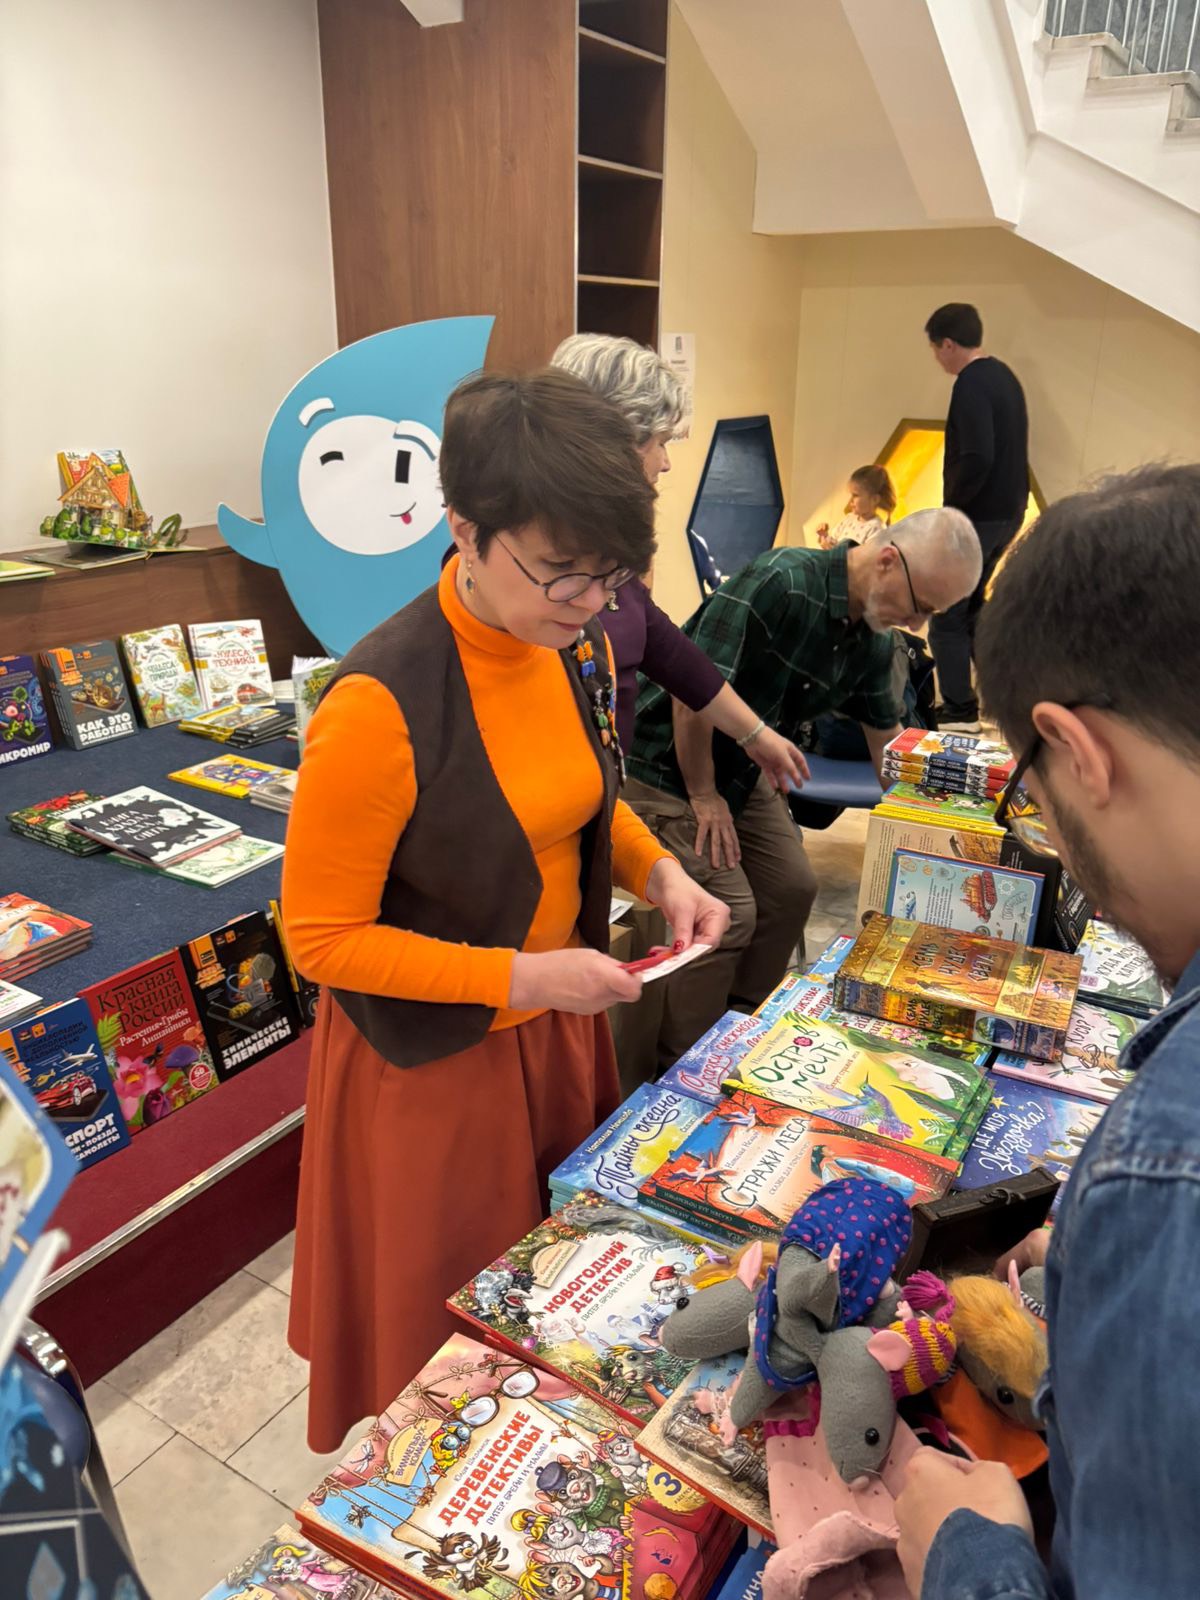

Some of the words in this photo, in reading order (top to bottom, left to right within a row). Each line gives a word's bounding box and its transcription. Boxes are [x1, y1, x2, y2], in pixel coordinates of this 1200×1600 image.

[76, 718, 105, 734] КАК
[107, 712, 131, 726] ЭТО
[79, 721, 133, 742] РАБОТАЕТ
[97, 967, 177, 1012] Красная
[129, 980, 182, 1014] книга
[118, 993, 186, 1034] России
[221, 1016, 289, 1058] ХИМИЧЕСКИЕ
[223, 1025, 292, 1070] ЭЛЕМЕНТЫ
[680, 1054, 733, 1095] Сказки
[715, 1016, 760, 1051] снежного
[748, 1024, 820, 1083] Остров
[585, 1130, 613, 1154] Наталия
[775, 1117, 812, 1151] ЛЕСА
[972, 1131, 994, 1150] ГДЕ
[981, 1112, 1010, 1133] МОЯ
[593, 1134, 640, 1200] Тайны
[633, 1094, 681, 1136] океана
[543, 1240, 629, 1314] НОВОГОДНИЙ
[570, 1257, 633, 1314] ДЕТЕКТИВ
[438, 1410, 531, 1528] ДЕРЕВЕНСКИЕ
[464, 1424, 544, 1527] ДЕТЕКТИВЫ
[503, 1477, 525, 1501] БРЕЙН
[653, 1471, 683, 1497] 3
